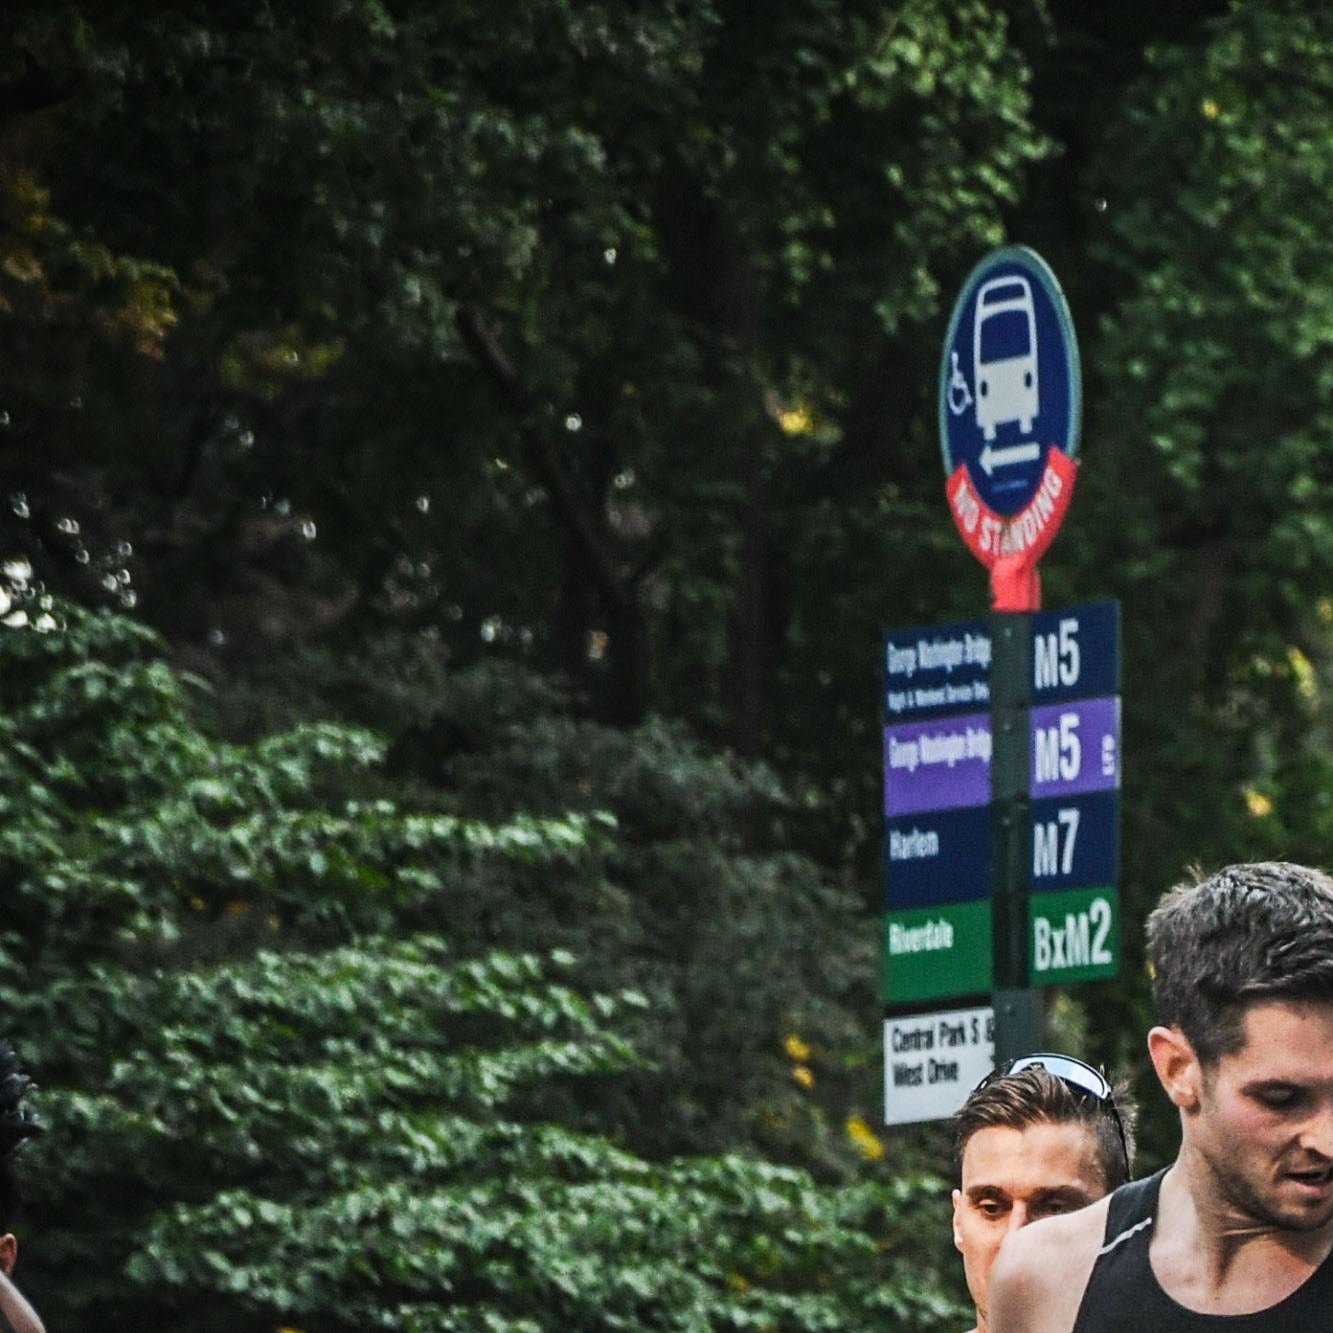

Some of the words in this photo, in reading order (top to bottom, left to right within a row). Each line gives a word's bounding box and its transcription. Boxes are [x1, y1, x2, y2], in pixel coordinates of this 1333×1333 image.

[1034, 618, 1080, 690] M5
[1034, 712, 1081, 783] M5
[1033, 807, 1080, 877] M7
[1034, 897, 1112, 971] BxM2
